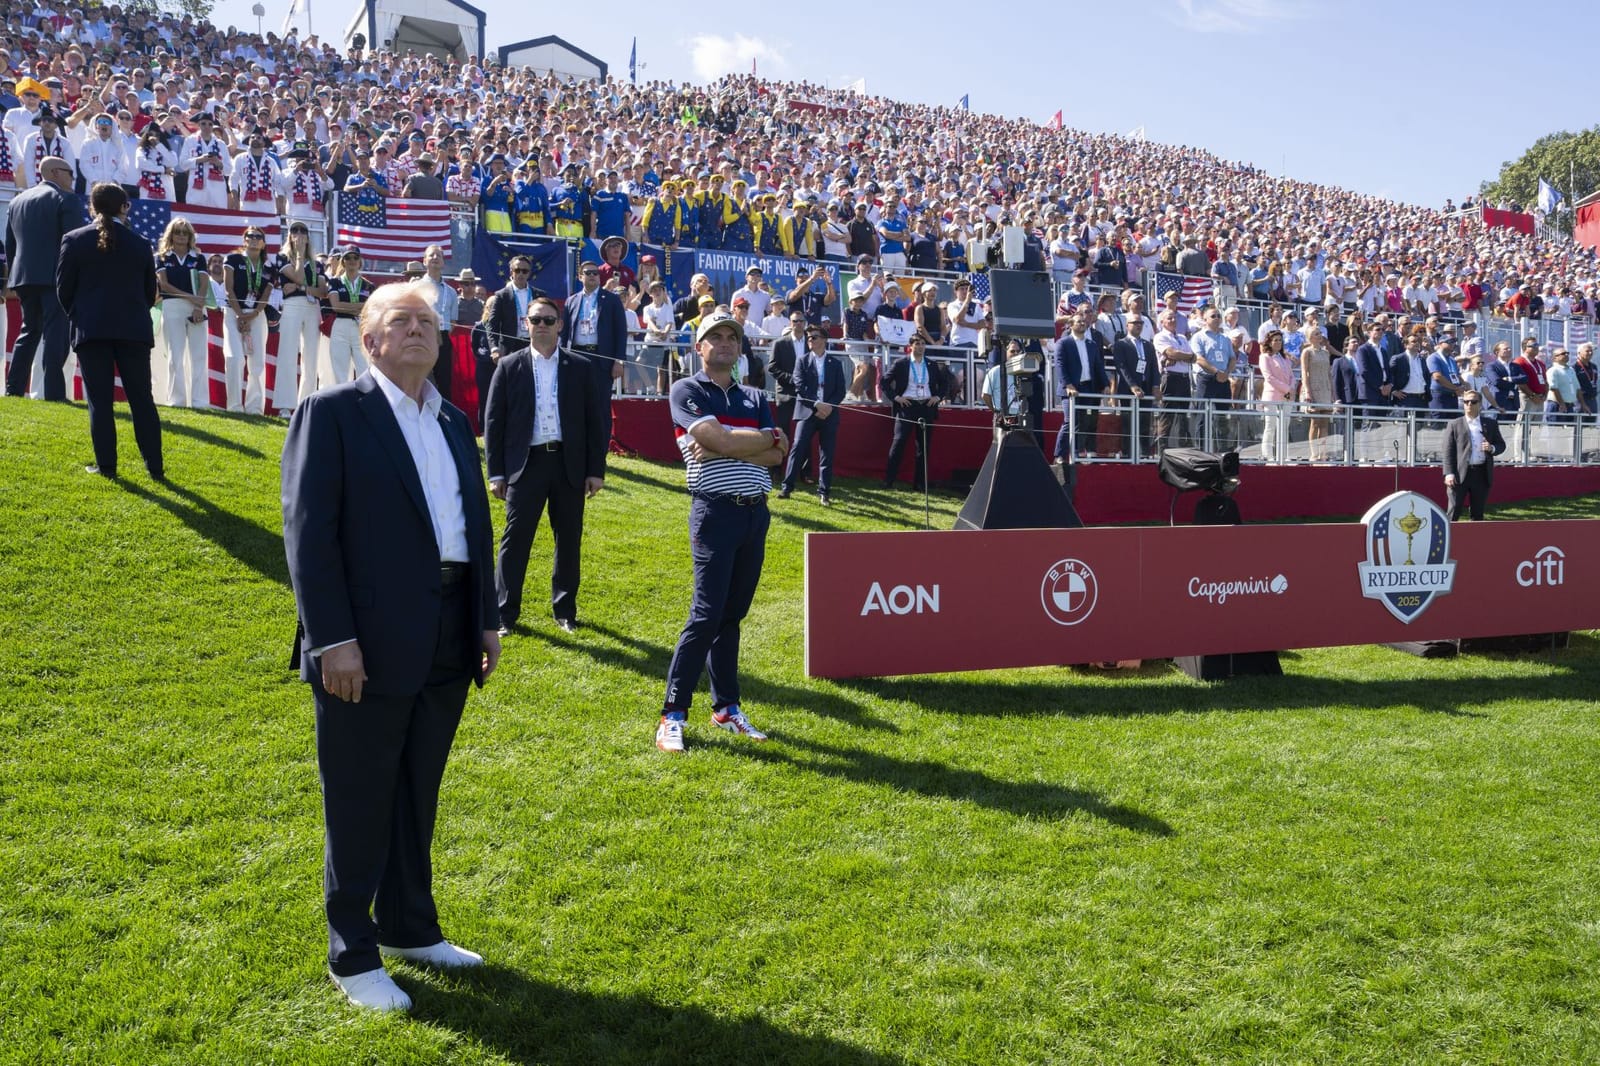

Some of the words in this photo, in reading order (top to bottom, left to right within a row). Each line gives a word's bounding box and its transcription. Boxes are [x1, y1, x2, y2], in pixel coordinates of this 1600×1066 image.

[698, 253, 757, 273] FAIRYTALE
[759, 258, 773, 275] OF
[775, 260, 799, 277] NEW
[1049, 562, 1090, 581] BMW
[1516, 545, 1565, 587] citi
[1188, 576, 1269, 605] Capgemini
[1368, 571, 1417, 587] RYDER
[1419, 570, 1449, 585] CUP
[860, 581, 940, 616] AON
[1397, 595, 1421, 607] 2025
